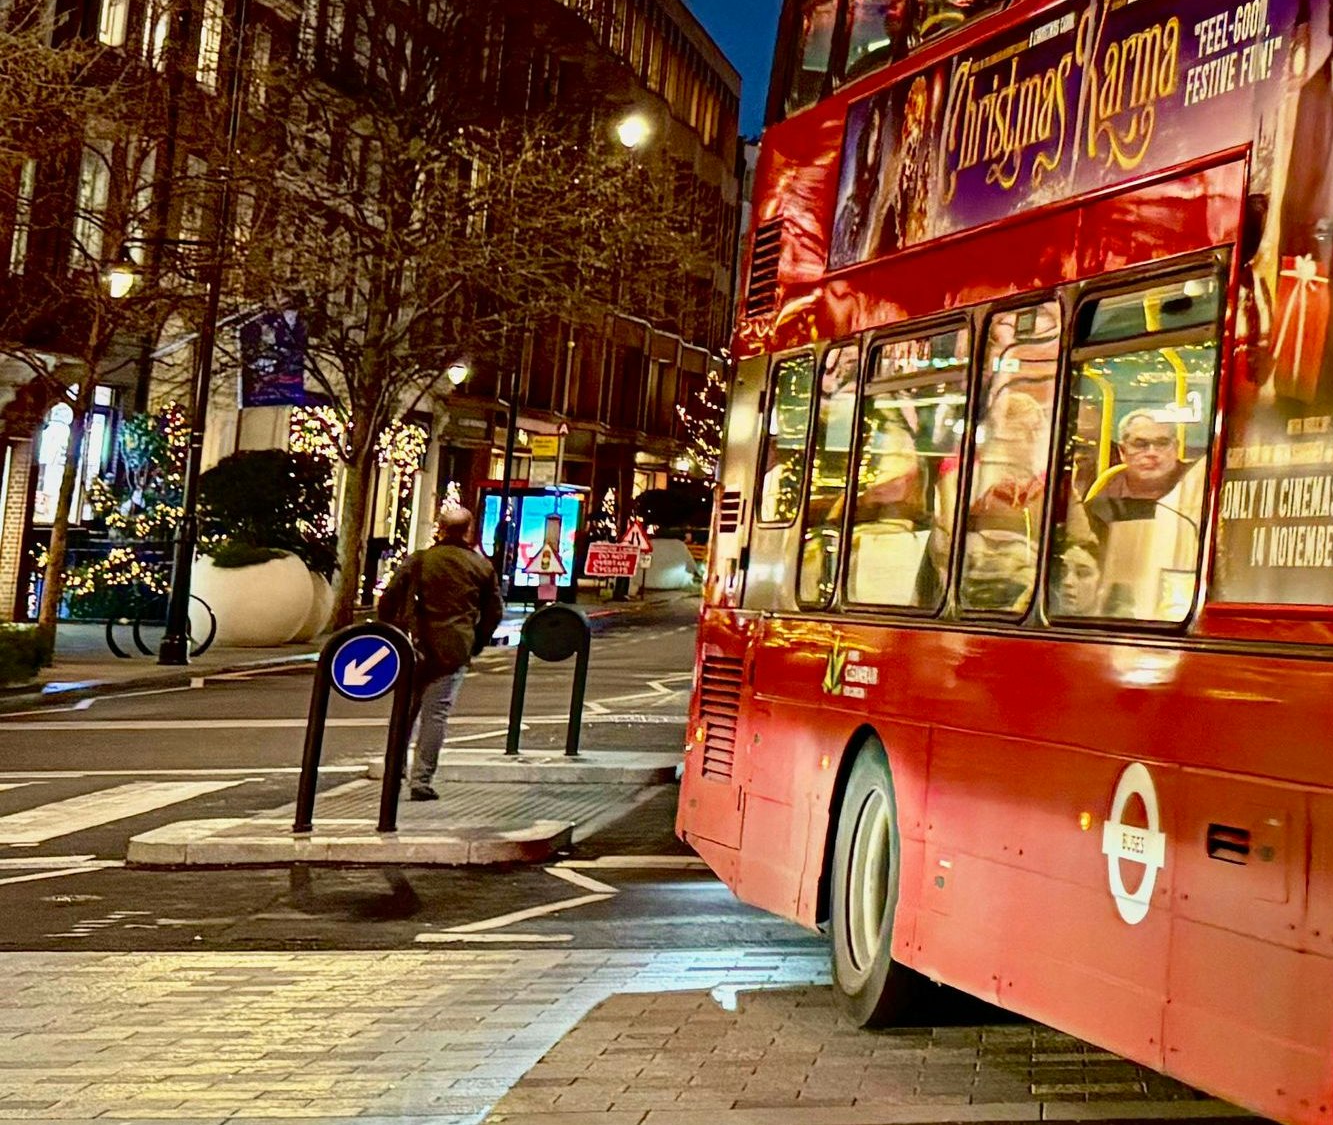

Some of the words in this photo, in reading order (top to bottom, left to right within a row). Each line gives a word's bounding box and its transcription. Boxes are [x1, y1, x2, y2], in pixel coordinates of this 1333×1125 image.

[1184, 51, 1239, 107] FESTIVE
[939, 52, 1073, 206] Christmas
[1222, 479, 1259, 520] ONLY
[1259, 478, 1277, 518] IN
[1250, 526, 1266, 566] 14
